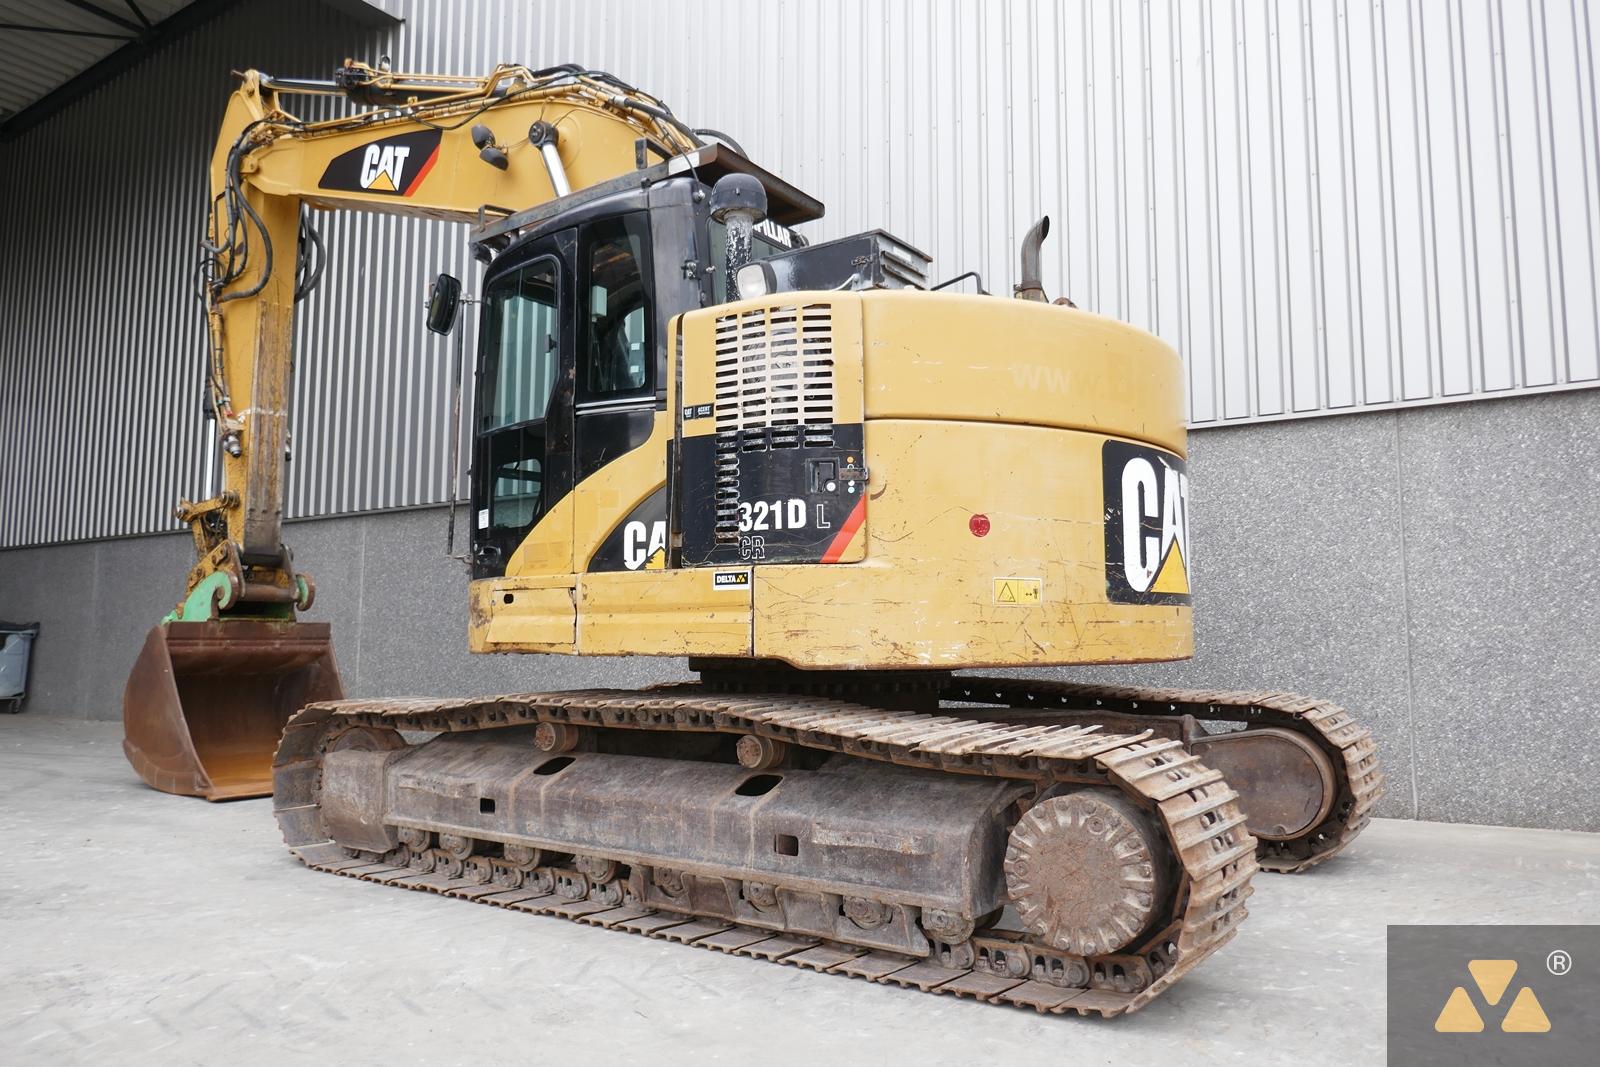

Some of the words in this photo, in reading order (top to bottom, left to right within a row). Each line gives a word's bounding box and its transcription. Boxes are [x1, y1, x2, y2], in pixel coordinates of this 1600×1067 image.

[360, 143, 411, 191] CAT
[739, 498, 807, 532] 321D
[816, 504, 831, 529] L
[623, 520, 667, 570] CA
[739, 535, 766, 560] CR
[716, 574, 737, 584] DELTA
